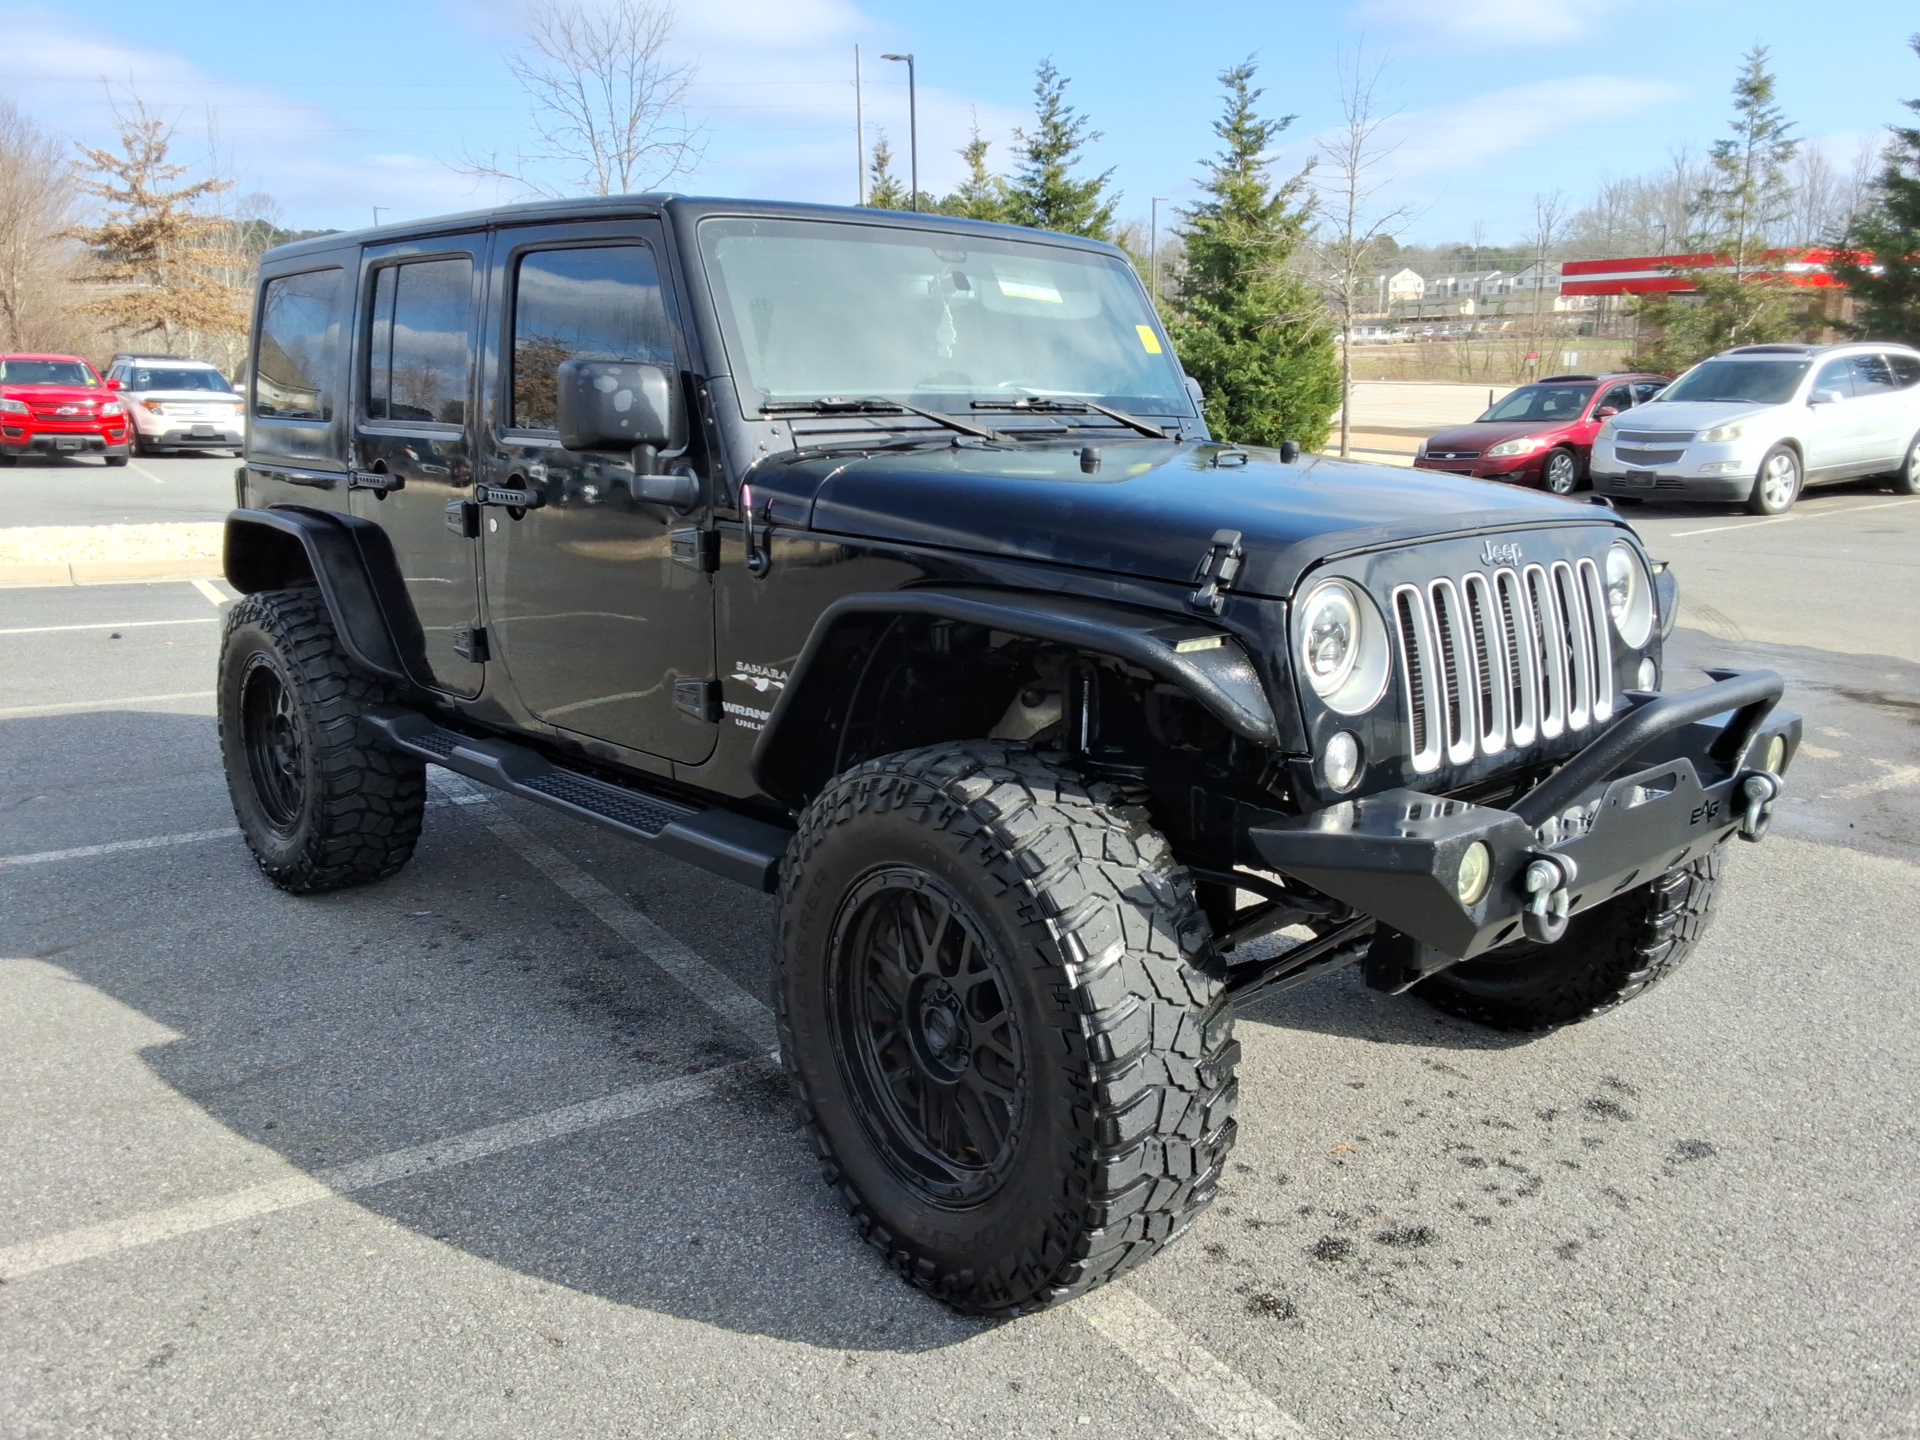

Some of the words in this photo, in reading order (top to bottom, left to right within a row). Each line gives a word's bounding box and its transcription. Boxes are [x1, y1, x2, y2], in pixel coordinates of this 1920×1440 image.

[1480, 540, 1522, 567] Jeep
[735, 661, 789, 681] SAHARA
[1690, 798, 1720, 826] EAG
